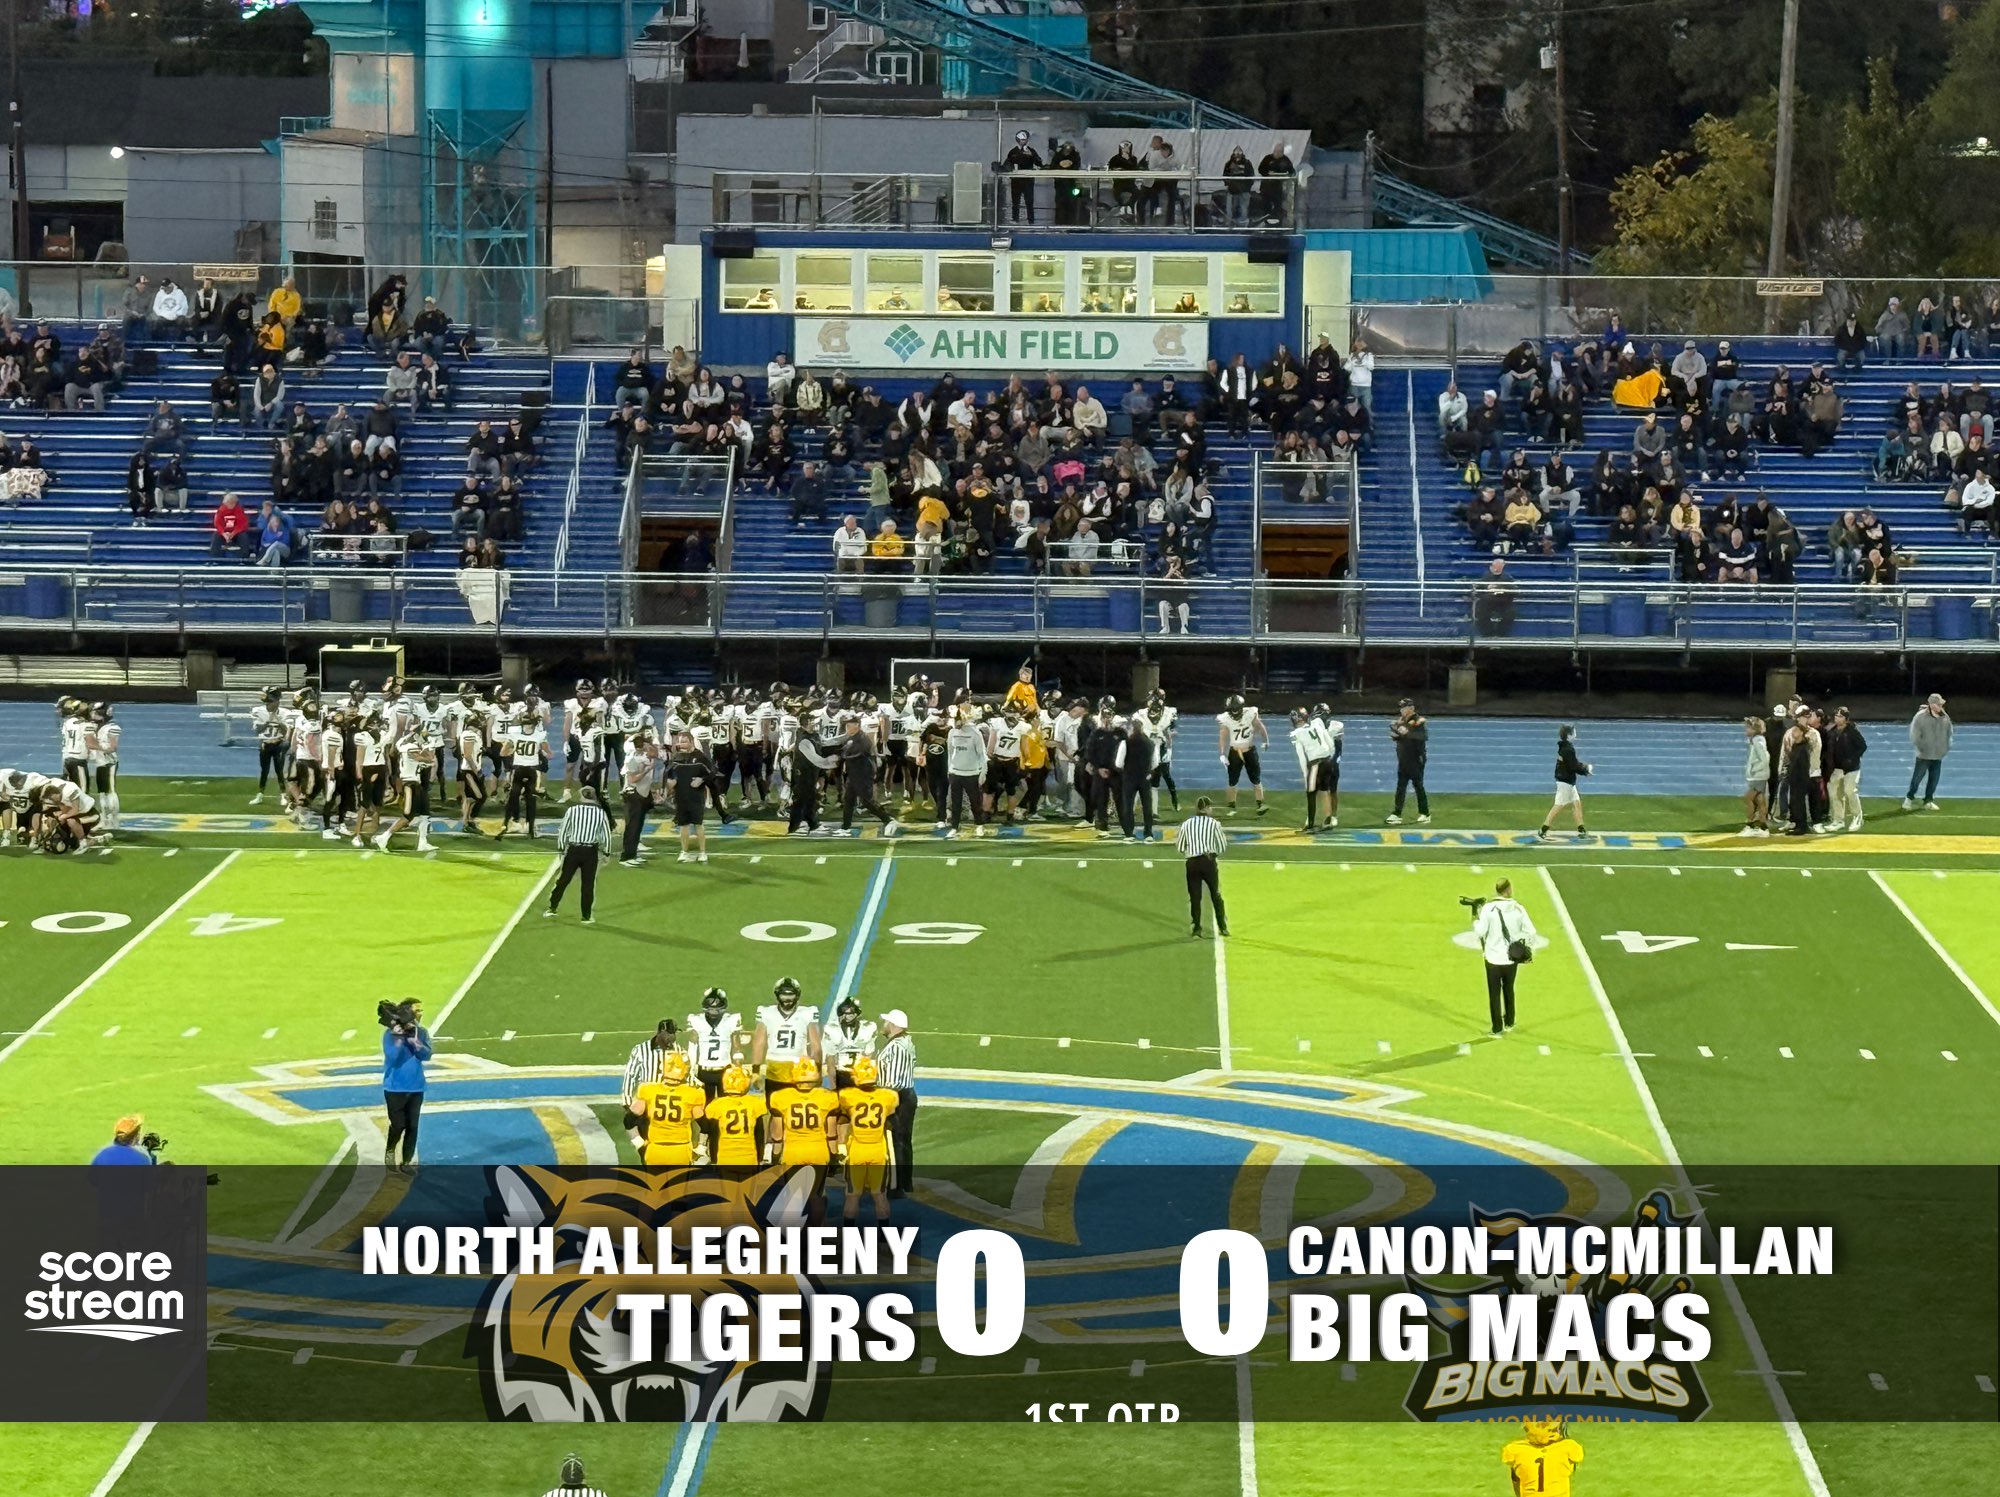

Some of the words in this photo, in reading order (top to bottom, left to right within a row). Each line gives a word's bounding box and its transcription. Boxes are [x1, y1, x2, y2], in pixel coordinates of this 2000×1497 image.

[930, 329, 1007, 359] AHN
[1020, 329, 1119, 360] FIELD
[707, 1039, 720, 1061] 2
[776, 1029, 796, 1049] 51
[653, 1094, 683, 1123] 55
[725, 1108, 749, 1135] 21
[790, 1102, 819, 1130] 56
[854, 1102, 884, 1129] 23
[1534, 1457, 1544, 1492] 1
